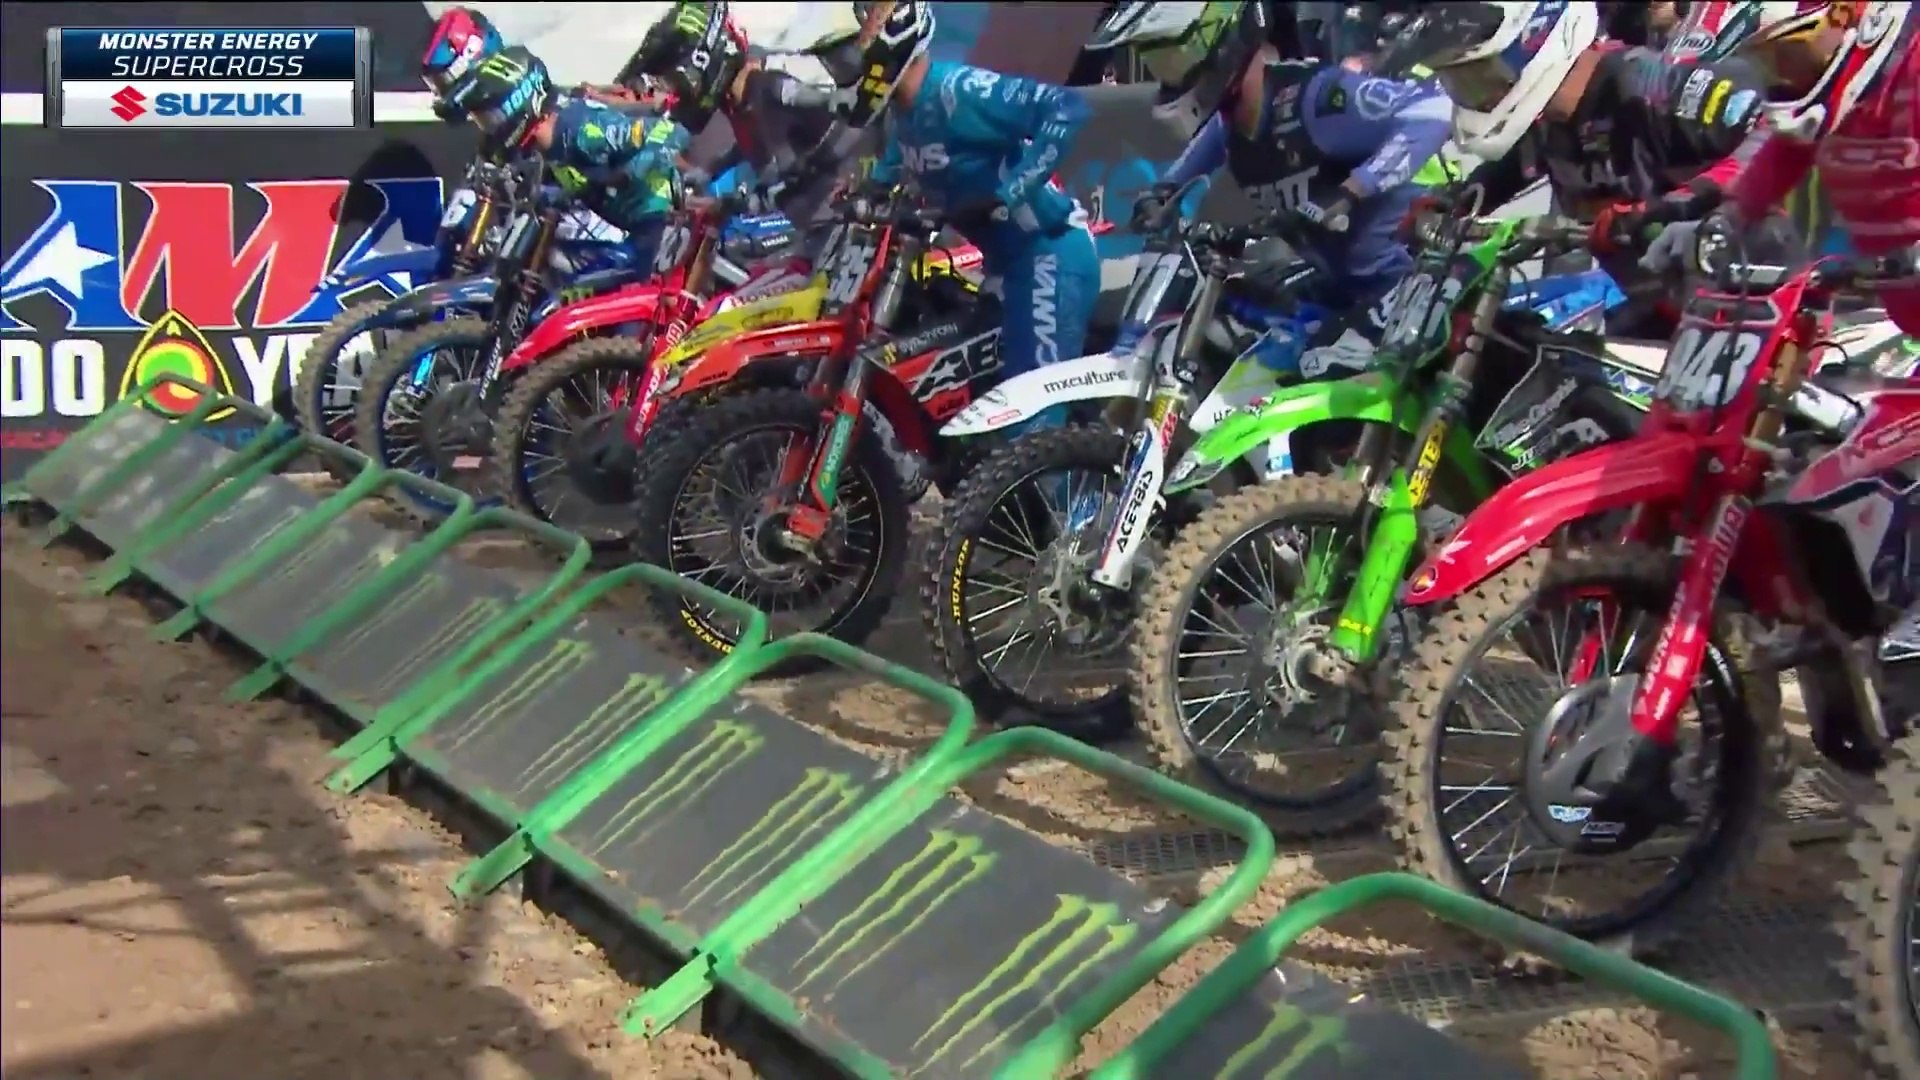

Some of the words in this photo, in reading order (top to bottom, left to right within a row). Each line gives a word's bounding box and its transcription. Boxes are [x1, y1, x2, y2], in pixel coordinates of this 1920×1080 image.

[0, 177, 444, 331] AMA
[1043, 366, 1129, 394] mxculture
[951, 539, 970, 621] DUNLOP
[680, 609, 733, 654] DUNLOP
